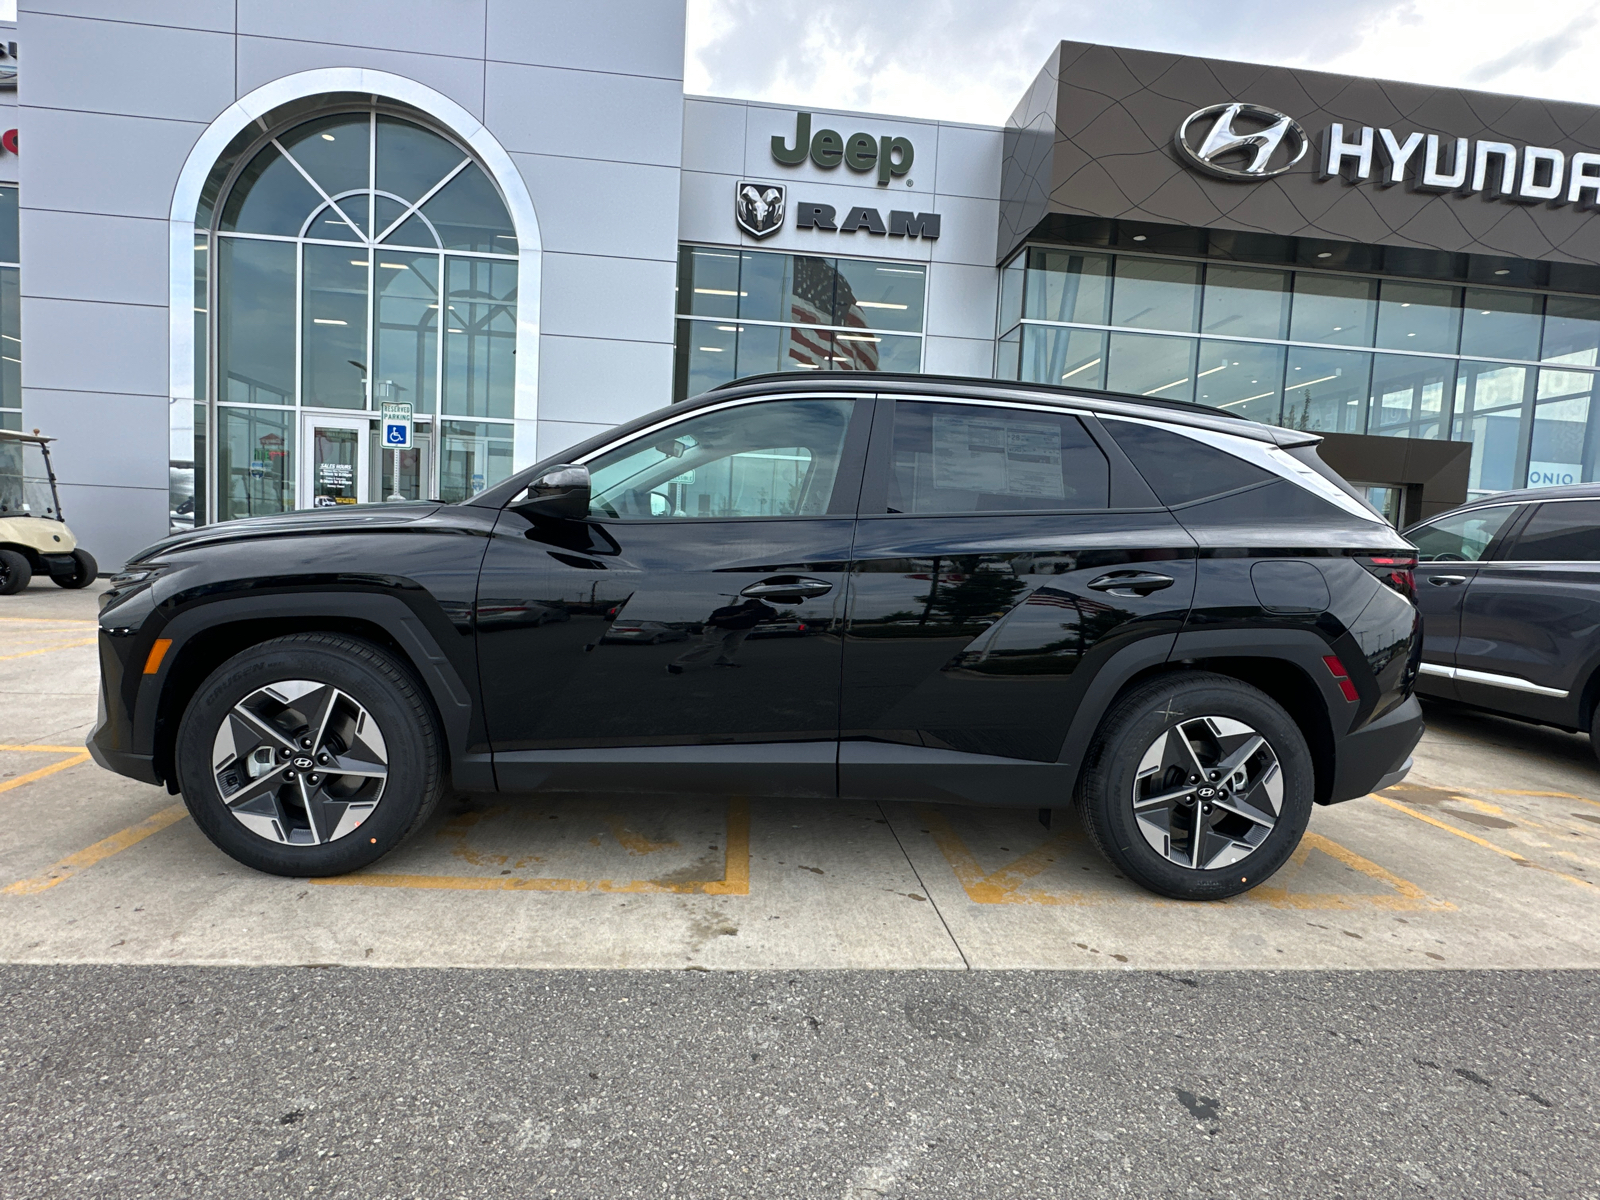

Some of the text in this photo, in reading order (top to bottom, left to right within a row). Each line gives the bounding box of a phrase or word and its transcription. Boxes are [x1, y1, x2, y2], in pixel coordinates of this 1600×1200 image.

[771, 111, 914, 186] Jeep
[1320, 122, 1600, 207] HYUNDA
[797, 202, 941, 240] RAM
[384, 405, 410, 413] RESERVED
[384, 413, 410, 421] PARKING
